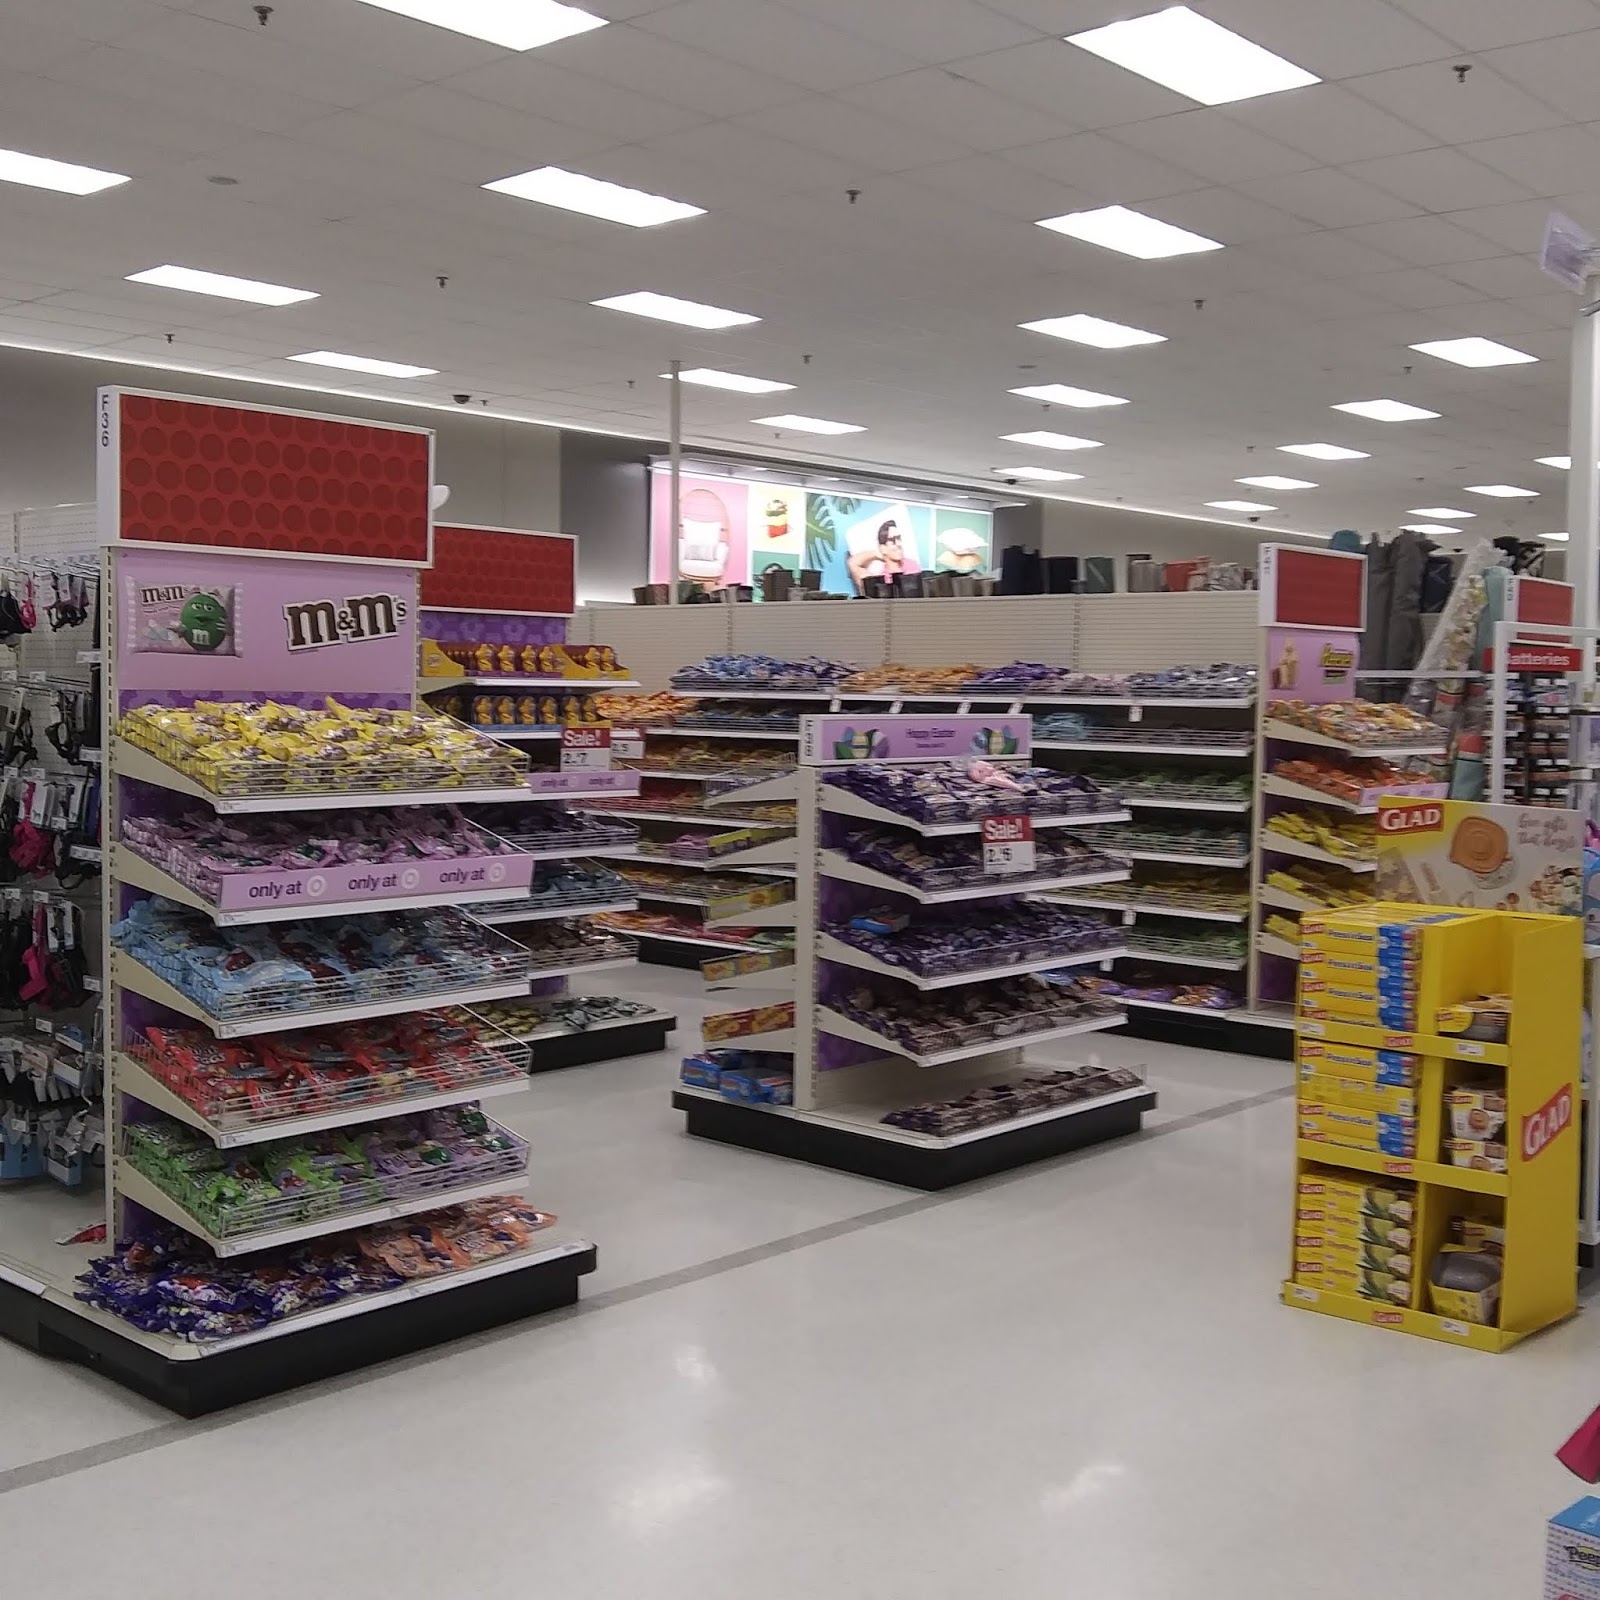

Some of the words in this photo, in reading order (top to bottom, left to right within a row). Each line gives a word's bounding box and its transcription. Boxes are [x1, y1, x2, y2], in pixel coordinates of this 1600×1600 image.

[101, 394, 109, 447] F36
[1508, 652, 1570, 666] atteries
[563, 729, 602, 747] Sale!
[984, 818, 1024, 840] Sale!
[1380, 808, 1442, 831] GLAD
[348, 874, 380, 892] only
[382, 873, 397, 888] at
[439, 868, 469, 885] only
[470, 867, 485, 881] at
[249, 882, 283, 900] only
[286, 880, 302, 895] at
[1525, 1094, 1571, 1156] GLAD
